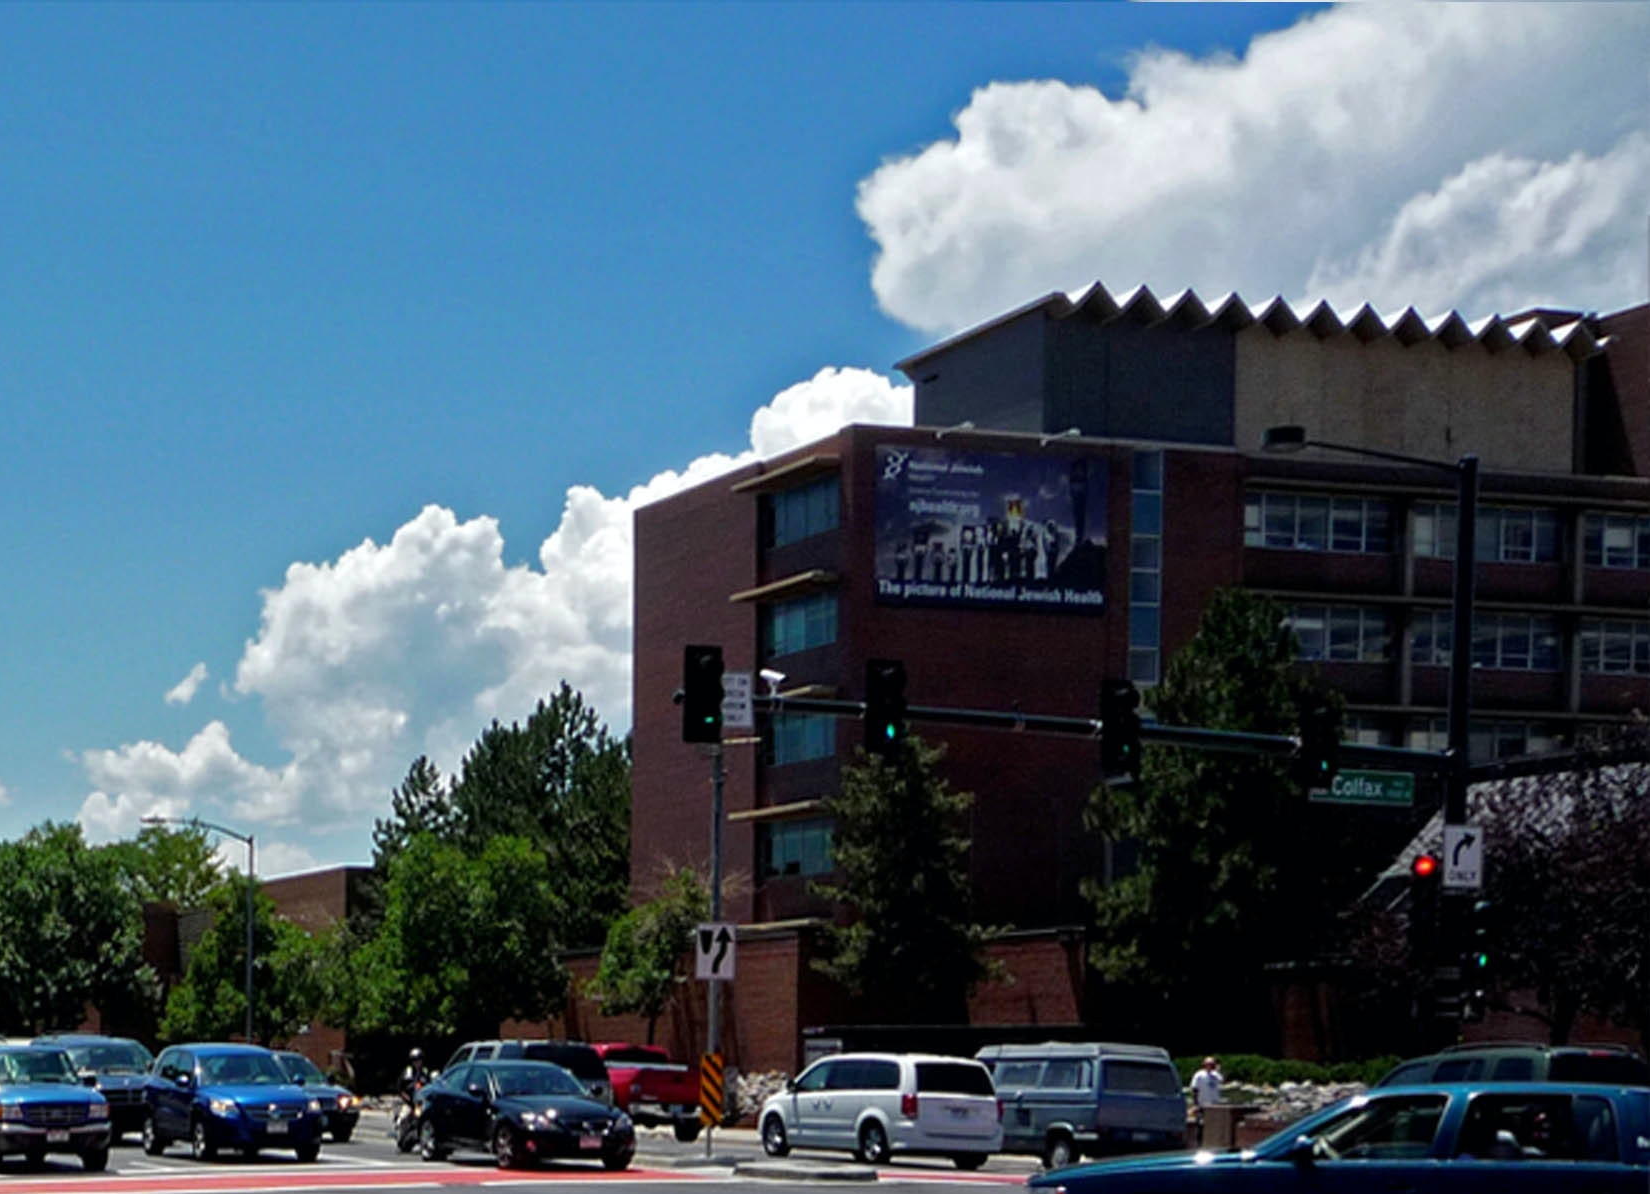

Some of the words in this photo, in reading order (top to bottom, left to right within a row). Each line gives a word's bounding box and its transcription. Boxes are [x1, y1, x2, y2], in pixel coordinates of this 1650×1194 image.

[878, 579, 901, 595] The
[904, 582, 947, 598] picture
[950, 583, 962, 597] of
[964, 584, 1017, 600] National
[1018, 586, 1062, 602] Jewish
[1064, 588, 1104, 605] Health
[1331, 774, 1383, 797] Colfax
